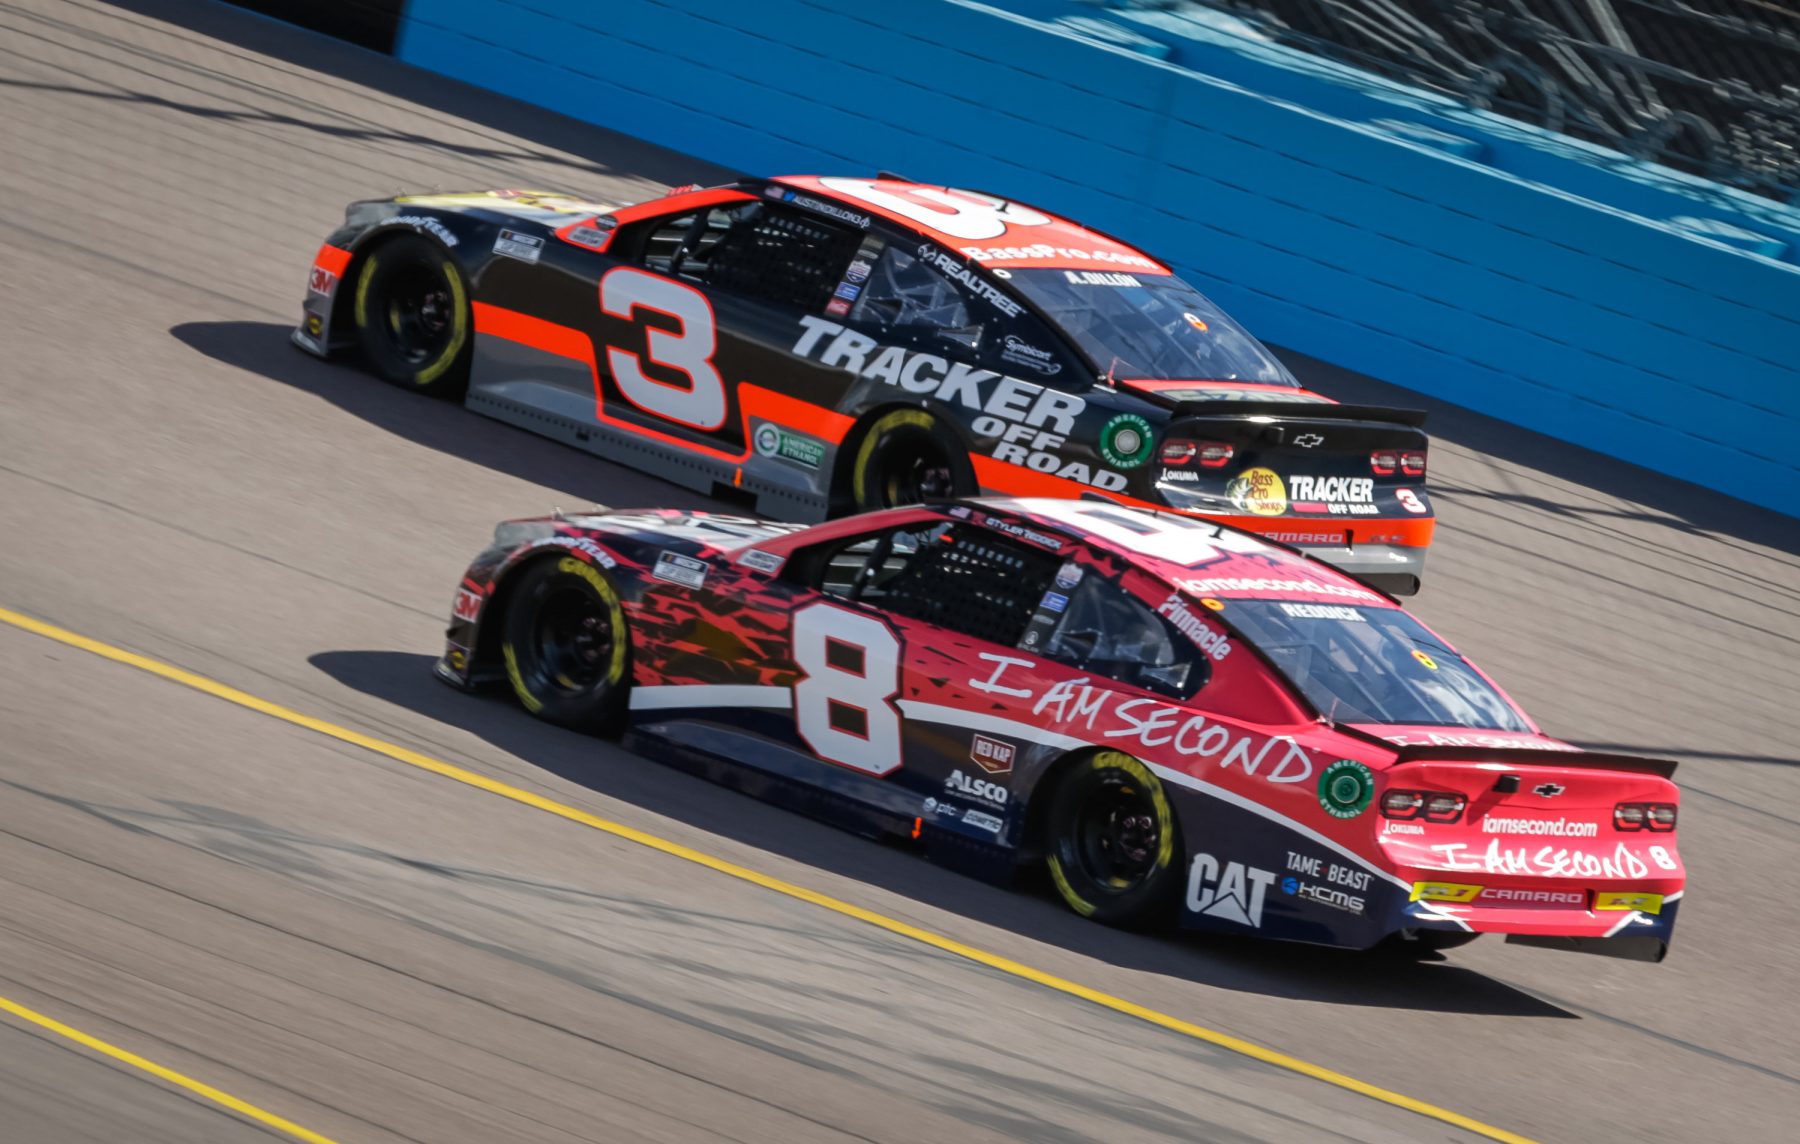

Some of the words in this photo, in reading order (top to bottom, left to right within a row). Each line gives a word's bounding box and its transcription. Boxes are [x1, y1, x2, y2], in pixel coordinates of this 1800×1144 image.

[959, 243, 1157, 271] BassPro.com
[310, 265, 335, 295] 3M
[931, 252, 1021, 319] REALTREE
[1064, 270, 1141, 288] A.DILLON
[599, 265, 727, 432] 3
[791, 313, 1086, 436] TRACKER
[971, 414, 1065, 450] OFF
[1108, 413, 1152, 438] AMERICAN
[992, 440, 1128, 492] ROAD
[1102, 448, 1140, 468] ETHANOL
[1167, 471, 1199, 481] OKUMA
[1250, 468, 1274, 486] Bass
[1289, 475, 1374, 504] TRACKER
[1250, 486, 1269, 499] Pro
[1396, 488, 1427, 514] 3
[1328, 504, 1347, 514] OFF
[1349, 504, 1380, 514] ROAD
[1256, 531, 1343, 543] AMARO
[455, 590, 481, 621] 3M
[1174, 577, 1388, 606] iamsecond.com
[1280, 602, 1366, 623] REDDICK
[1157, 594, 1233, 661] Pinnacle
[791, 602, 904, 776] 8
[967, 652, 1037, 699] I
[1032, 676, 1114, 731] AM
[1104, 697, 1314, 783] SECOND
[975, 740, 994, 758] RED
[992, 744, 1012, 763] KAP
[945, 769, 1008, 803] ALSCO
[1326, 760, 1375, 786] AMERICAN
[1320, 798, 1362, 818] ETHANOL
[1482, 815, 1598, 837] iamsecond.com
[1287, 852, 1322, 877] TAME
[1327, 864, 1375, 891] BEAST
[1431, 843, 1480, 869] I
[1481, 838, 1533, 873] AM
[1533, 842, 1648, 878] SECOND
[1649, 846, 1676, 869] 8
[1186, 853, 1277, 928] CAT
[1299, 881, 1365, 911] KCMG
[1480, 888, 1583, 903] CAMARO
